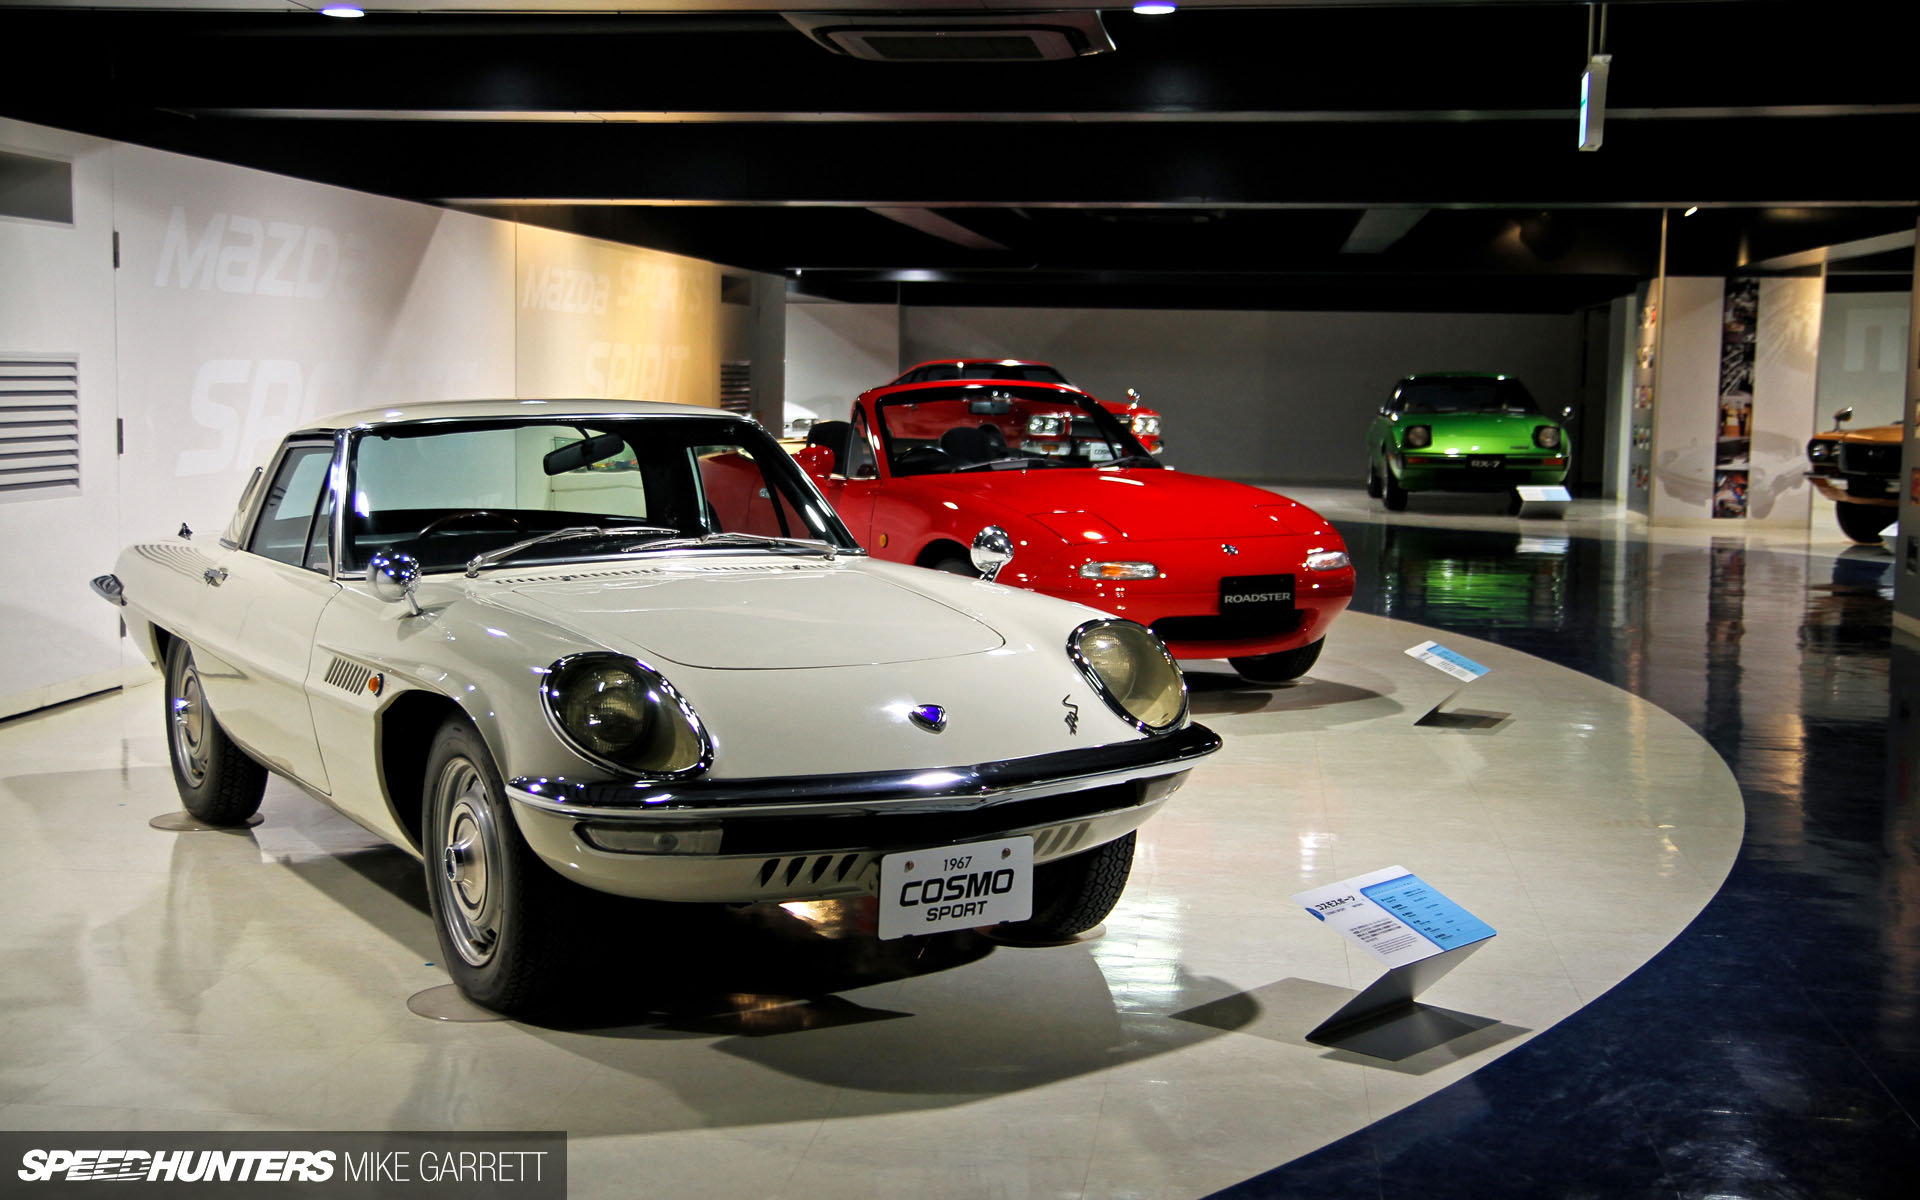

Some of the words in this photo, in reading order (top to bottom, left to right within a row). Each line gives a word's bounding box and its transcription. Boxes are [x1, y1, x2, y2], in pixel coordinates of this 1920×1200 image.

[1471, 460, 1501, 469] RX-7
[1224, 592, 1291, 604] ROADSTER
[943, 856, 973, 872] 1967
[900, 868, 1014, 907] COSMO
[926, 901, 988, 922] SPORT
